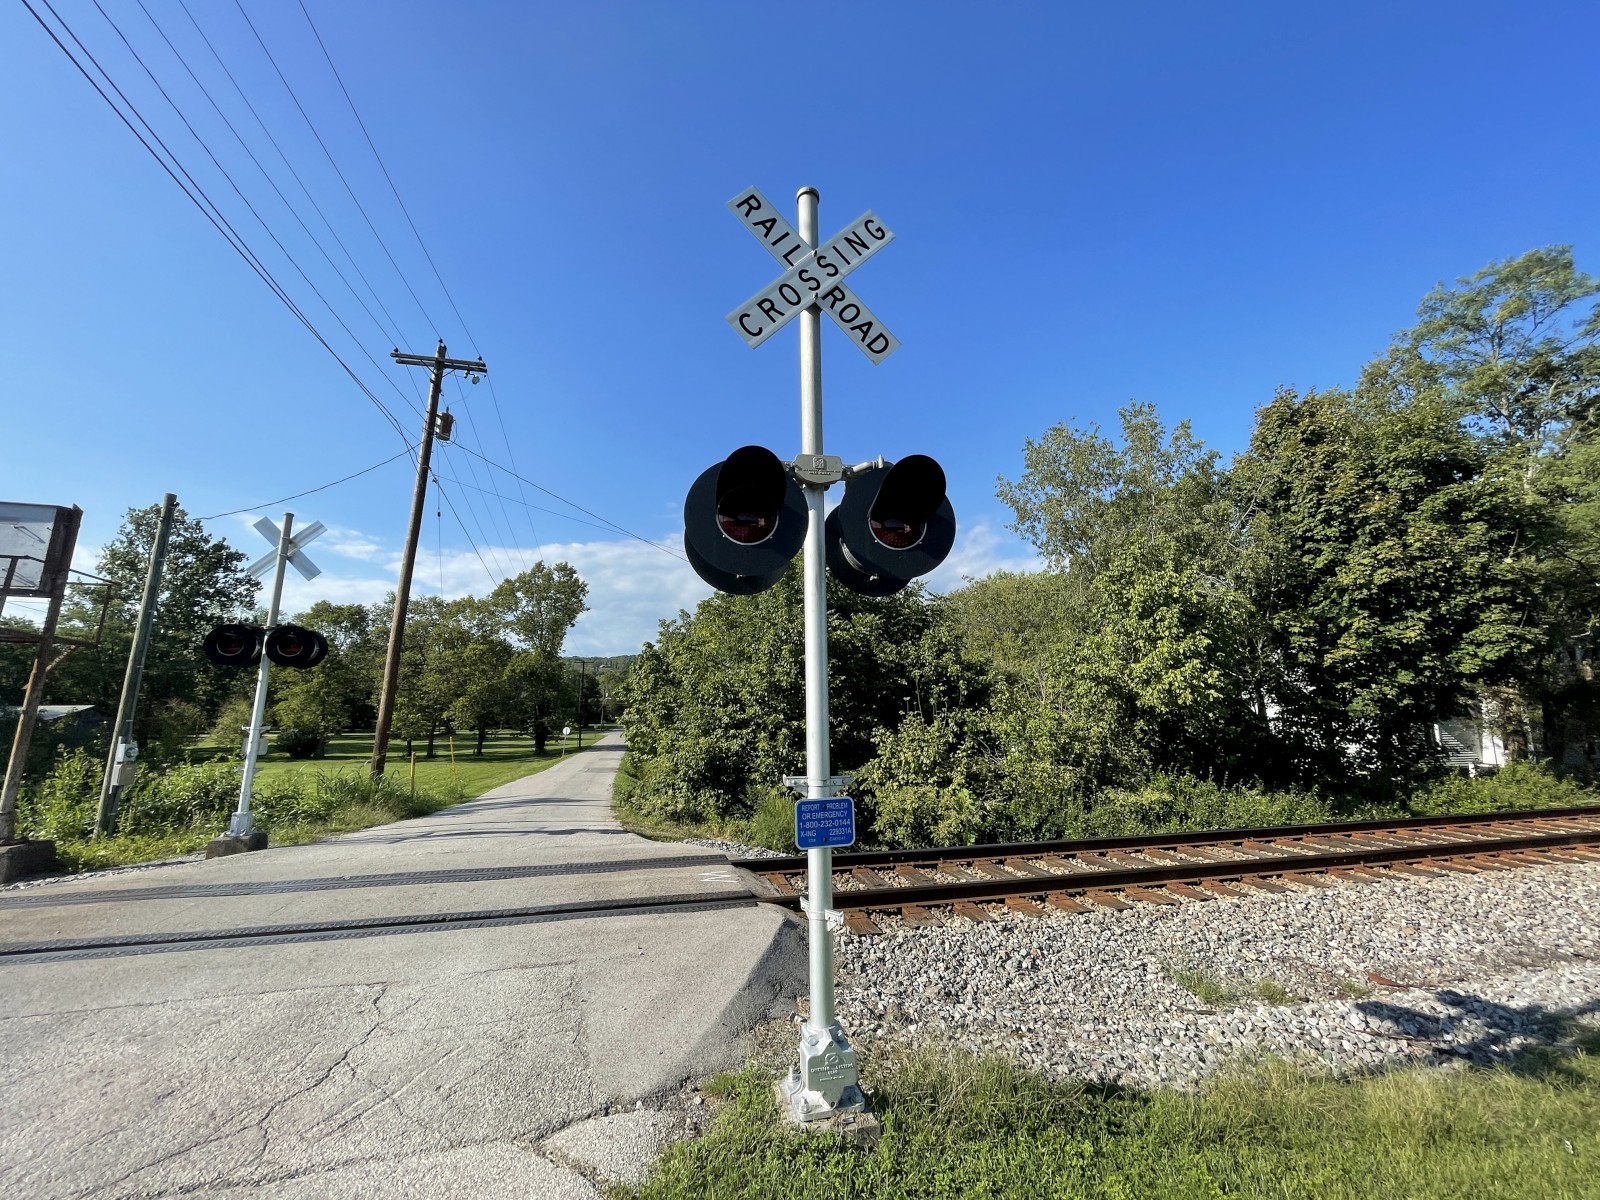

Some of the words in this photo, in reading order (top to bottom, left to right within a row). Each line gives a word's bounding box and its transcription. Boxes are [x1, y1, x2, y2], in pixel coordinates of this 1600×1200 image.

[735, 193, 801, 267] RAIL
[821, 285, 889, 355] ROAD
[738, 219, 886, 337] CROSSING
[800, 819, 850, 829] 1-800-232-0144
[802, 812, 811, 820] OR
[812, 811, 847, 820] EMERGENCY
